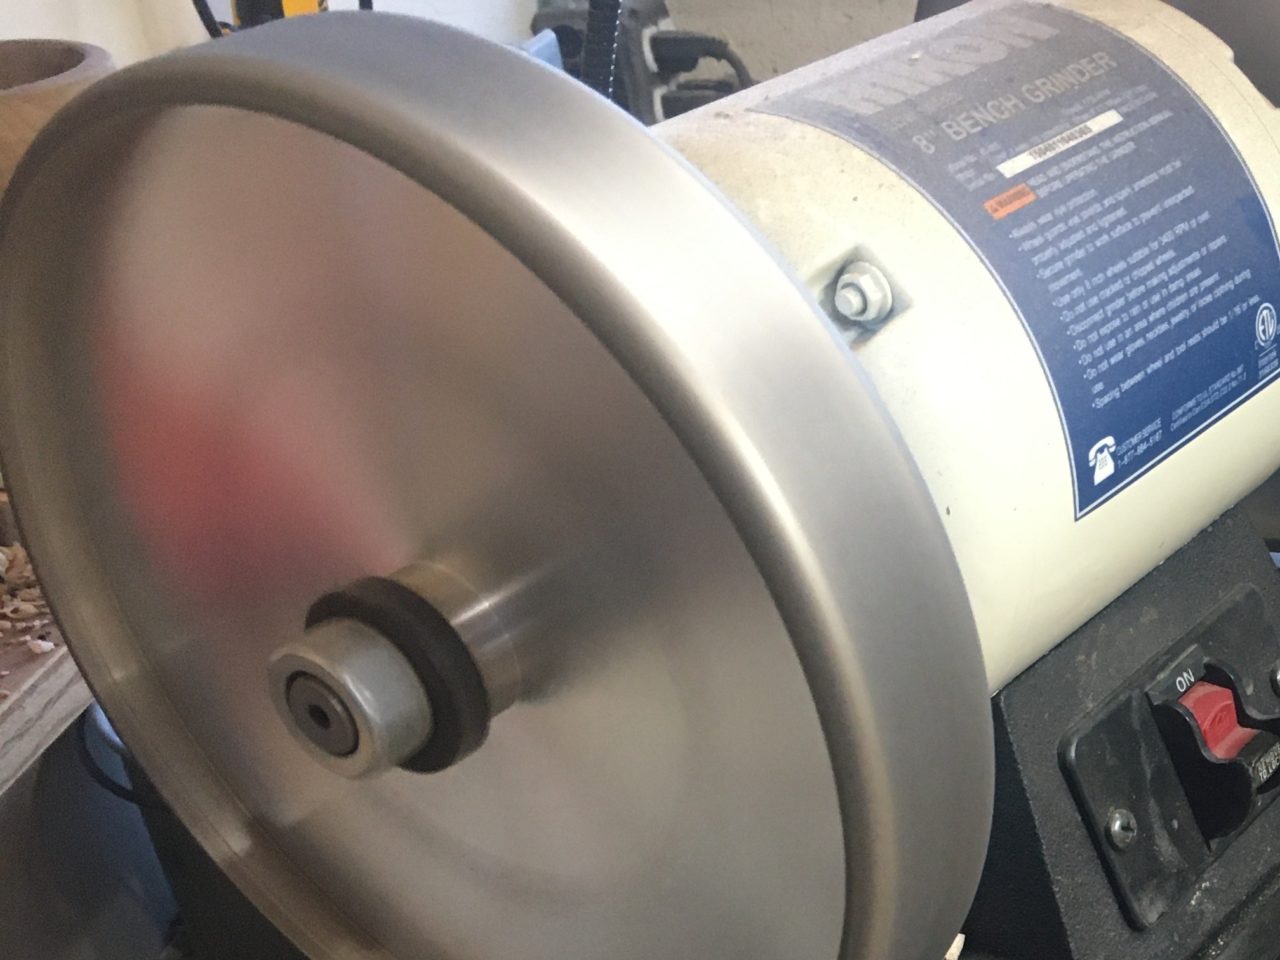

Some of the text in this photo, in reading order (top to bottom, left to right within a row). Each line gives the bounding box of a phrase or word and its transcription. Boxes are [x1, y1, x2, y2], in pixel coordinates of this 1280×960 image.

[940, 94, 1025, 141] BENCH
[1020, 51, 1119, 103] GRINDER
[1116, 430, 1142, 456] CUSTOMER
[1141, 417, 1162, 438] SERVICE
[1176, 668, 1195, 692] ON
